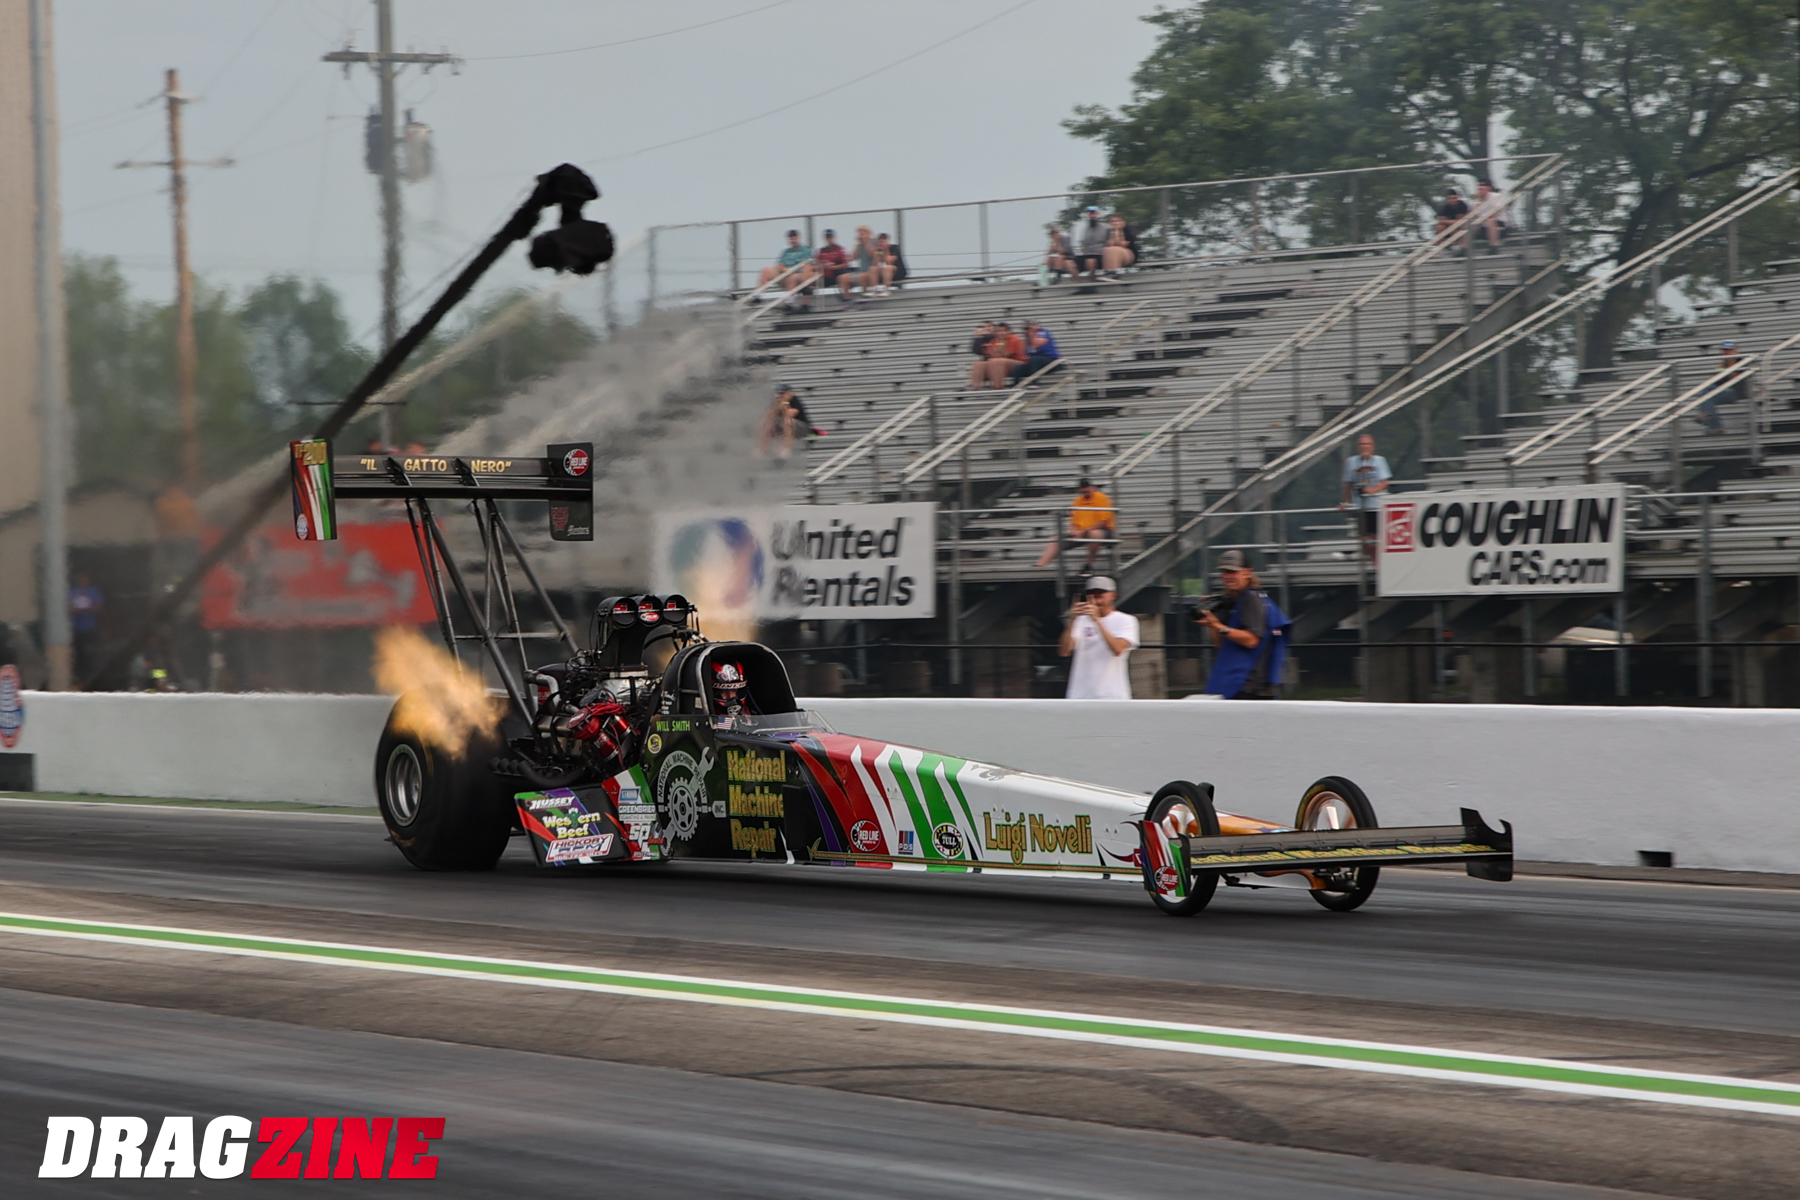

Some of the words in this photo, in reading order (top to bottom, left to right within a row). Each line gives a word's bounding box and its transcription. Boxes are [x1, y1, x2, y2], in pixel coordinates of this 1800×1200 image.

[360, 458, 377, 471] "IL
[403, 458, 448, 472] GATTO
[471, 459, 512, 473] NERO"
[1420, 497, 1617, 547] COUGHLIN
[771, 517, 906, 560] United
[1469, 550, 1609, 585] CARS.com
[772, 564, 916, 606] Rentals
[656, 720, 670, 732] WILL
[672, 720, 691, 731] SMITH
[726, 749, 787, 782] National
[528, 796, 575, 810] HUSSEY
[729, 785, 784, 818] Machine
[554, 835, 608, 848] HICKORY
[556, 823, 589, 839] Beef
[730, 819, 776, 859] Repair
[859, 830, 869, 840] RED
[942, 836, 957, 846] TULL
[983, 812, 1027, 865] Luigi
[1029, 814, 1093, 854] Novelli
[898, 843, 914, 852] PDS
